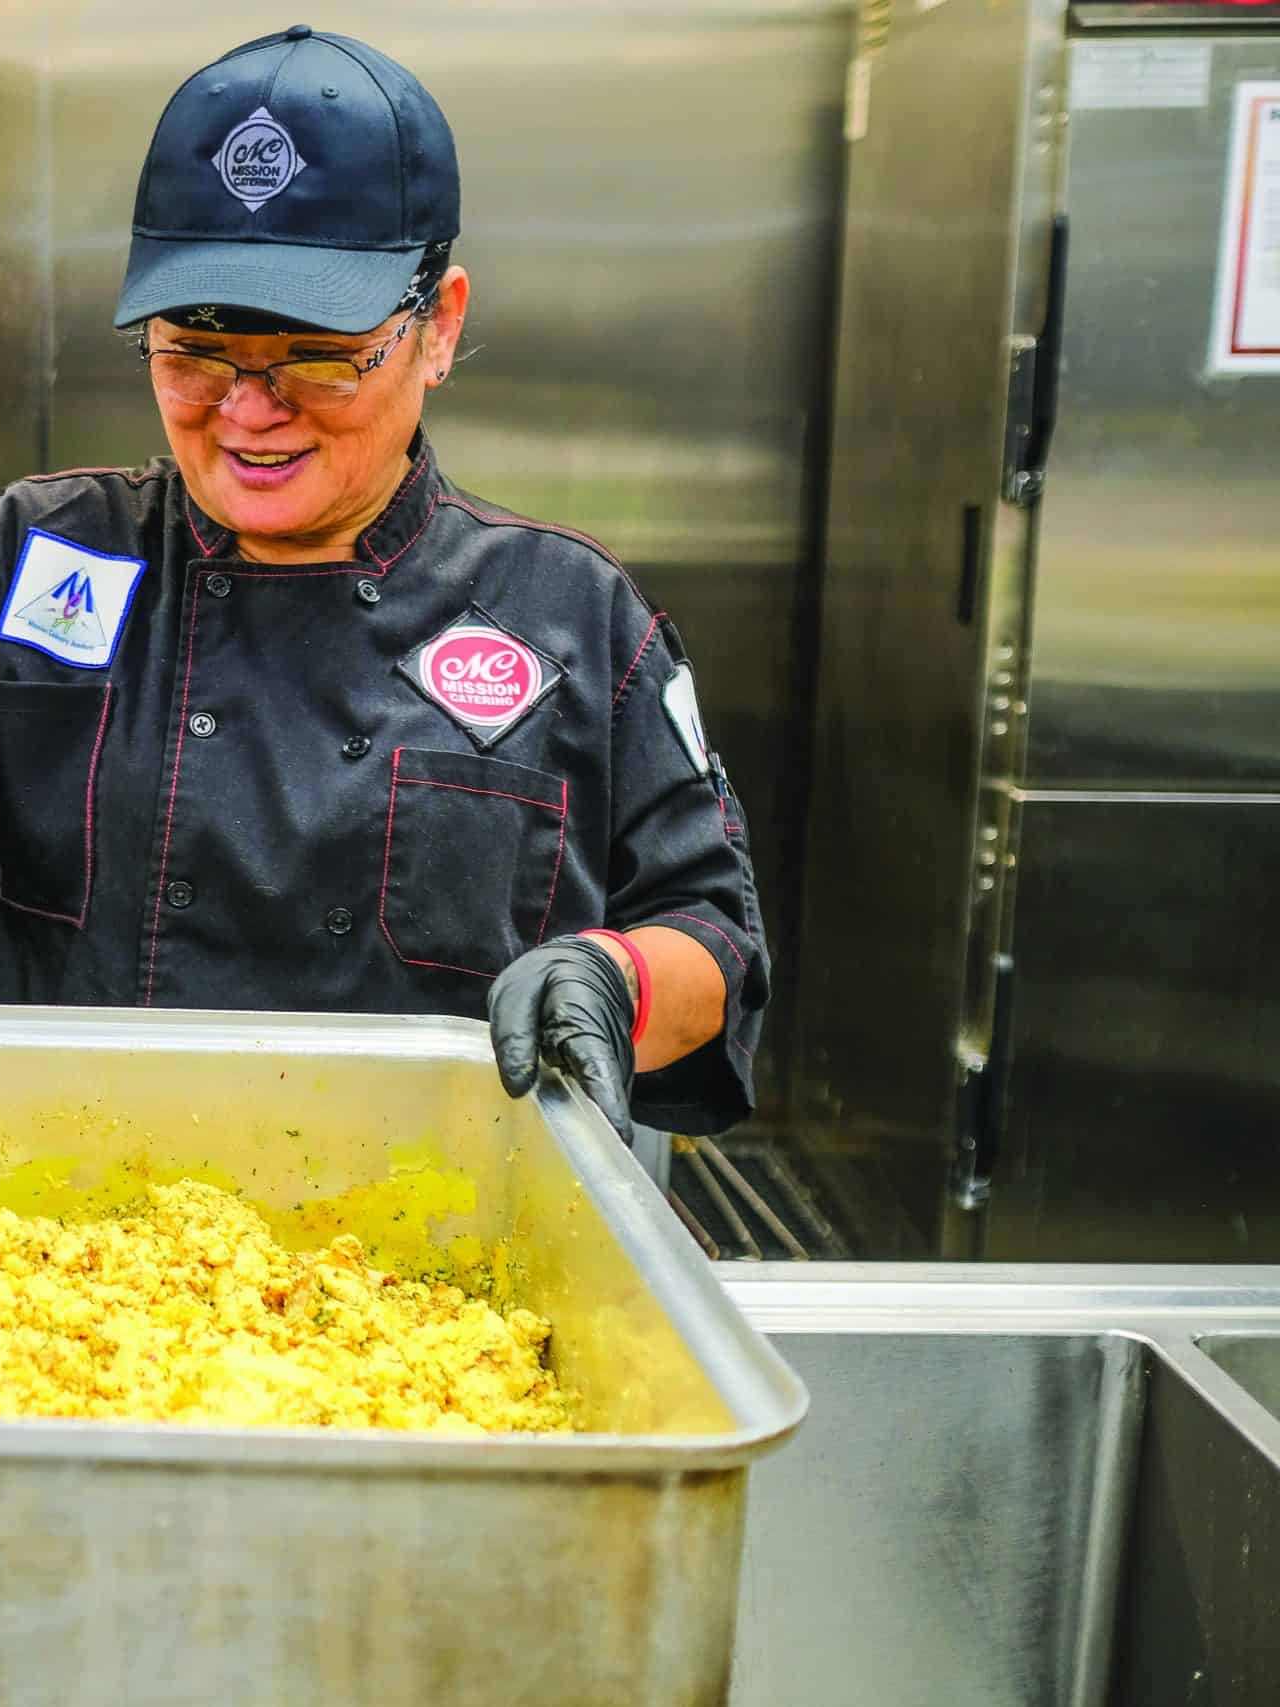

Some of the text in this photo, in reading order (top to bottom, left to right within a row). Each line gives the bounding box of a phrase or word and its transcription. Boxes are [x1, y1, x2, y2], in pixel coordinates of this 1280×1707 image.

[231, 165, 280, 177] MISSION
[442, 680, 520, 696] MISSION
[450, 693, 514, 706] CATERING
